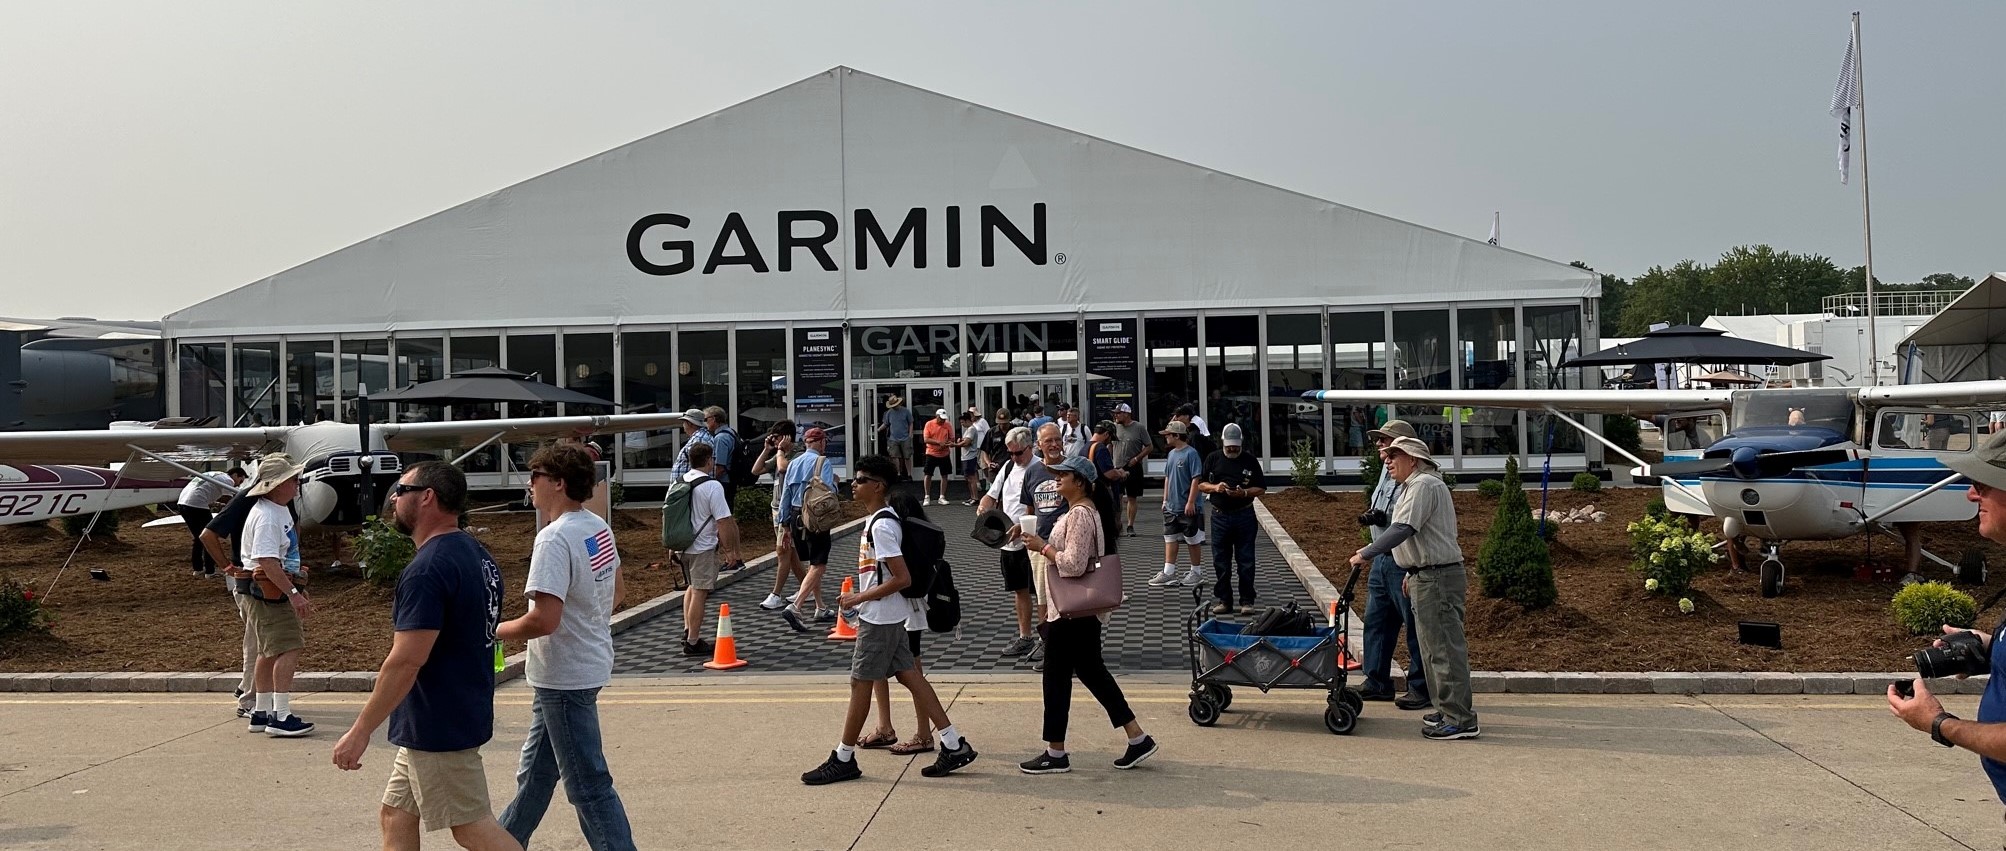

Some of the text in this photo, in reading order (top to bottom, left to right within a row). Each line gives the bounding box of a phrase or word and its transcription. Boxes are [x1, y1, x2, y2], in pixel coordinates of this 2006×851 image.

[626, 202, 1047, 276] GARMIN
[861, 322, 1048, 355] GARMIN
[1092, 337, 1112, 345] SMART
[933, 389, 943, 397] 09
[0, 494, 87, 516] 921C
